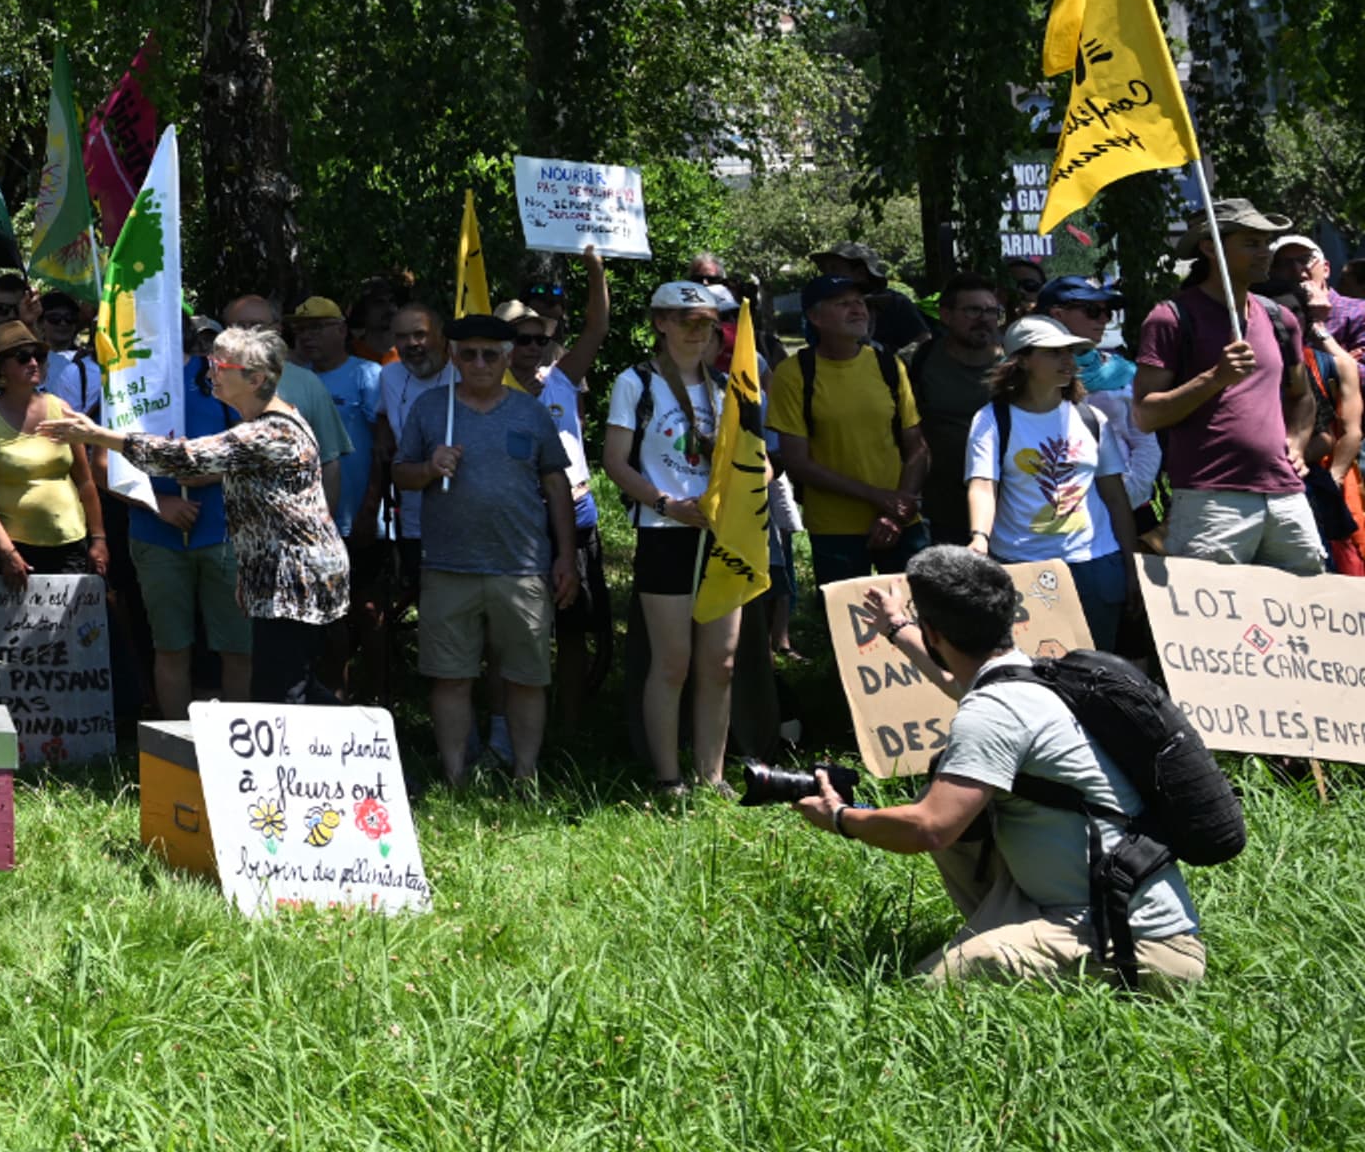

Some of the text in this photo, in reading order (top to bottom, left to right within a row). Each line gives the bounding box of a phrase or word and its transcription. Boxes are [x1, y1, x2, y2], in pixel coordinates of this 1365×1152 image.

[1168, 584, 1243, 621] LOI
[1163, 642, 1258, 677] CLASSÉE
[10, 667, 110, 692] PAYSANS
[229, 715, 290, 759] 80%
[309, 736, 333, 756] des
[1179, 701, 1255, 736] POUR
[1259, 709, 1309, 740] LES
[238, 765, 391, 813] à fleurs ont
